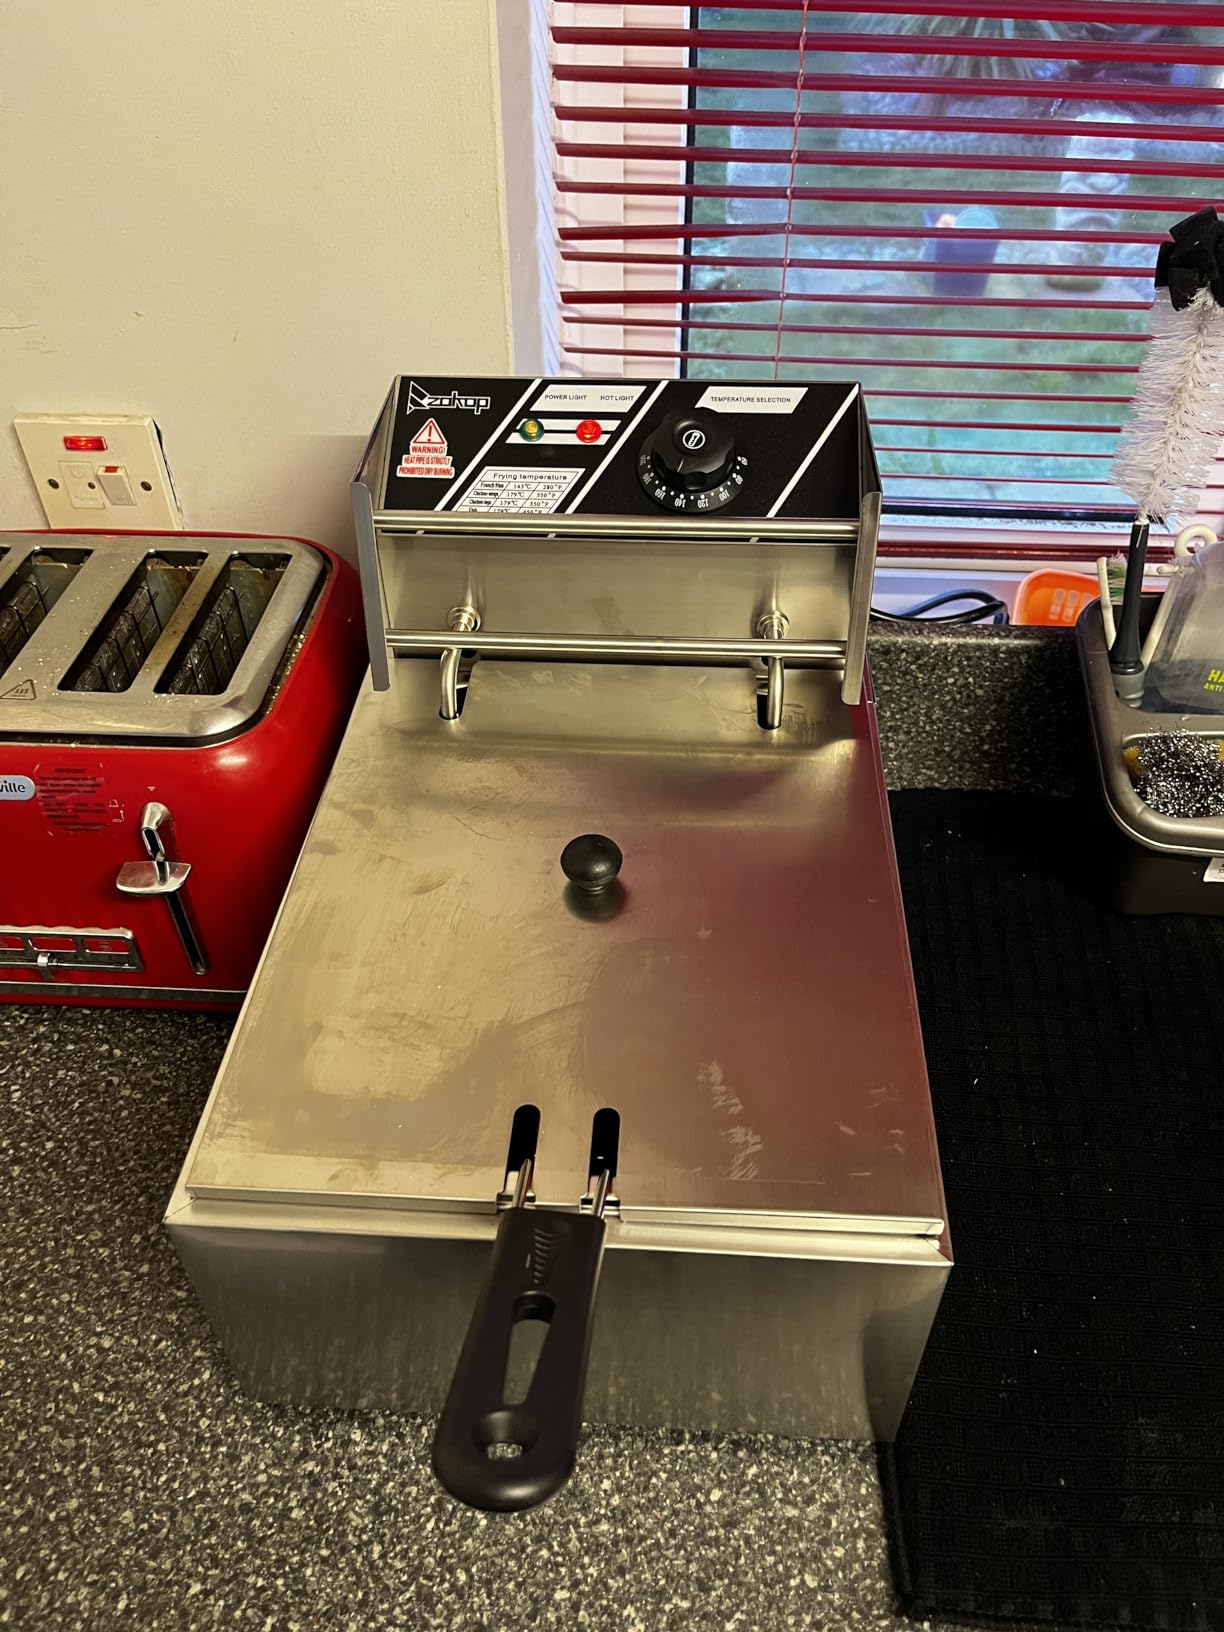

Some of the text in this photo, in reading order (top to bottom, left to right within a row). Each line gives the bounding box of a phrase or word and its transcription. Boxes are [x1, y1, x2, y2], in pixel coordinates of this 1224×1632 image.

[411, 446, 446, 454] WARNING!
[493, 472, 567, 481] Frying temperature
[654, 488, 666, 500] 160
[718, 489, 730, 501] 100
[674, 498, 686, 508] 140
[697, 498, 709, 508] 120
